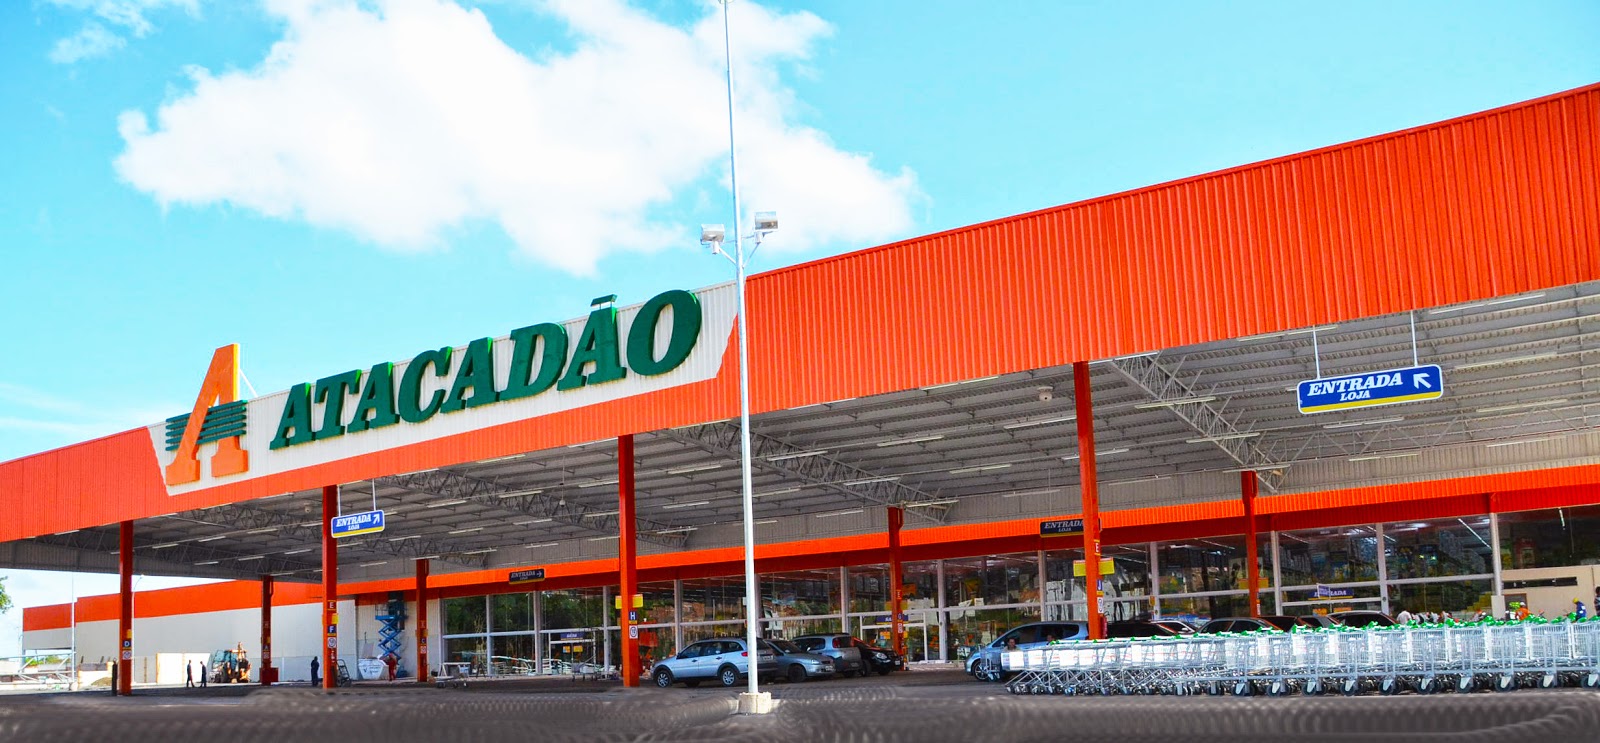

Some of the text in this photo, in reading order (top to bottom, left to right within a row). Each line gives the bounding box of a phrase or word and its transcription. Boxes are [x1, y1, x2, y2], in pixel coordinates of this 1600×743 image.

[269, 290, 701, 450] ATACADÃO
[1307, 372, 1403, 397] ENTRADA
[1339, 390, 1371, 402] LOJA
[336, 513, 372, 527] ENTRADA
[511, 570, 536, 578] ENTRADA
[630, 611, 636, 620] H
[329, 625, 335, 633] F
[123, 640, 130, 648] D
